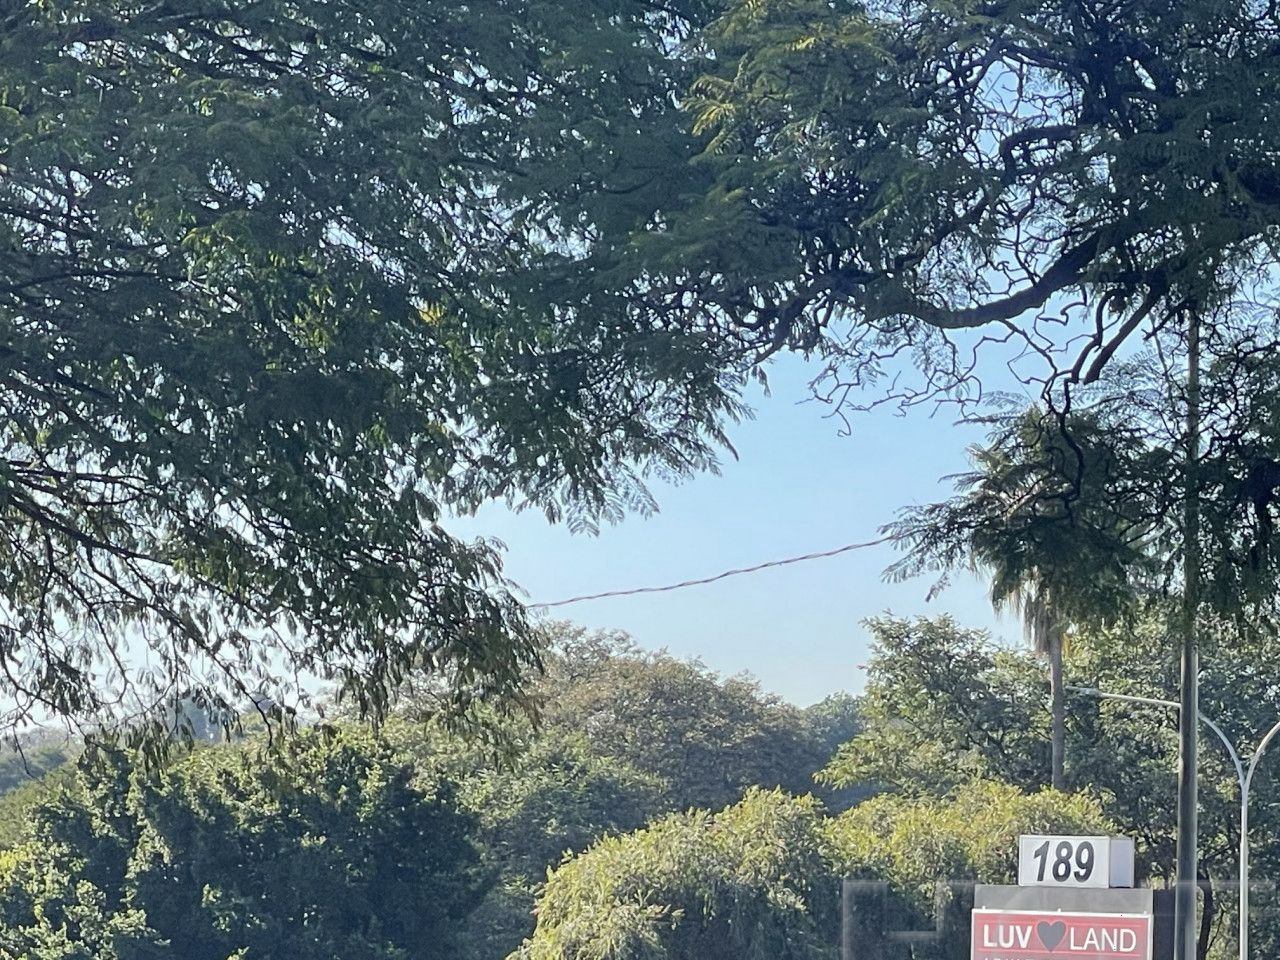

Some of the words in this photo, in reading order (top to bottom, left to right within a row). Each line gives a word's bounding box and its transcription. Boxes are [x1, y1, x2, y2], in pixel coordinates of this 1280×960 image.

[1033, 840, 1095, 883] 189
[983, 924, 1033, 949] LUV
[1069, 926, 1137, 953] LAND
